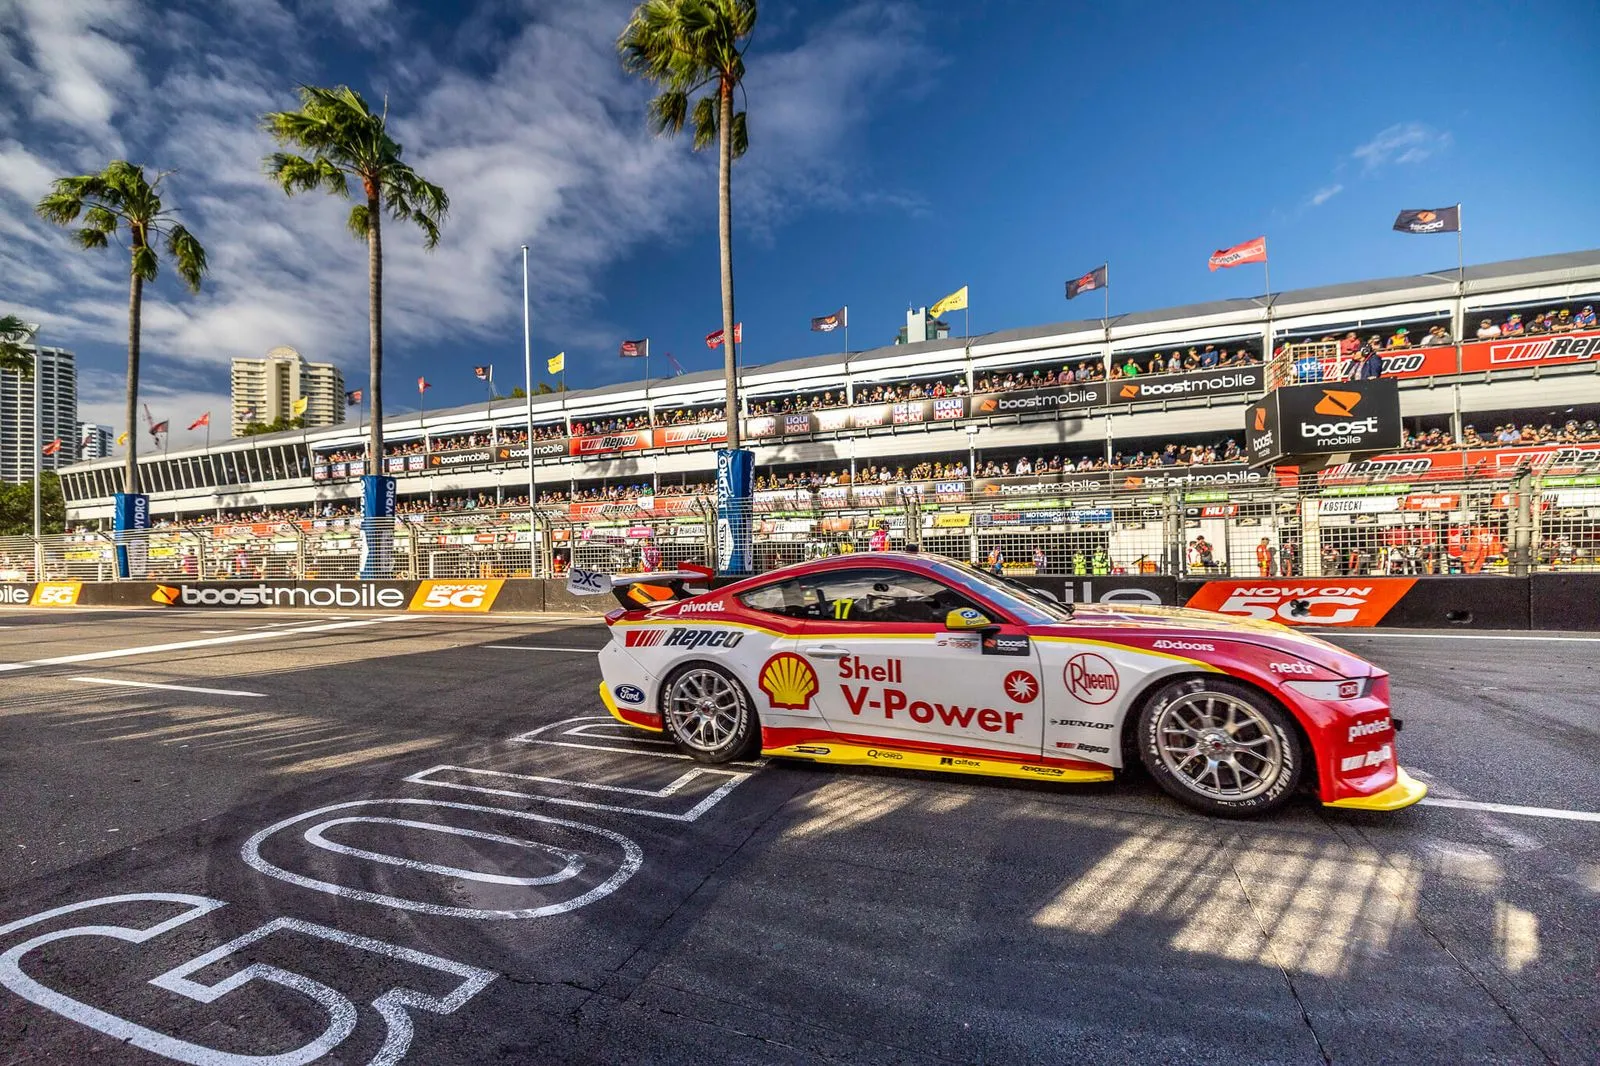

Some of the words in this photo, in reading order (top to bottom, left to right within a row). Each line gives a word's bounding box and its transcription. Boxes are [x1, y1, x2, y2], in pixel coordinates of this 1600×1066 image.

[1141, 373, 1257, 395] boostmobile
[935, 400, 963, 411] LIQUI
[999, 389, 1098, 409] boostmobile
[785, 415, 808, 425] LIQUI
[935, 409, 963, 420] MOLY
[785, 424, 809, 434] MOLY
[1301, 417, 1379, 438] boost
[601, 433, 639, 448] Repco
[1253, 430, 1274, 451] boost
[1317, 435, 1361, 446] mobile
[440, 451, 490, 465] boostmobile
[1323, 501, 1362, 512] KOSTECKI
[181, 583, 404, 607] boostmobile
[422, 590, 485, 608] 5G
[1231, 587, 1317, 597] NOW
[1319, 587, 1373, 597] ON
[832, 598, 854, 619] 17
[1217, 596, 1369, 624] 5G
[664, 627, 744, 650] Repco
[997, 639, 1028, 648] boost
[1152, 639, 1215, 652] 4Ddoors
[838, 656, 903, 684] Shell
[1069, 655, 1117, 696] Rheem
[619, 685, 641, 702] Ford
[840, 684, 1024, 735] V-Power
[1059, 719, 1115, 730] DUNLOP
[1077, 743, 1110, 754] Repco
